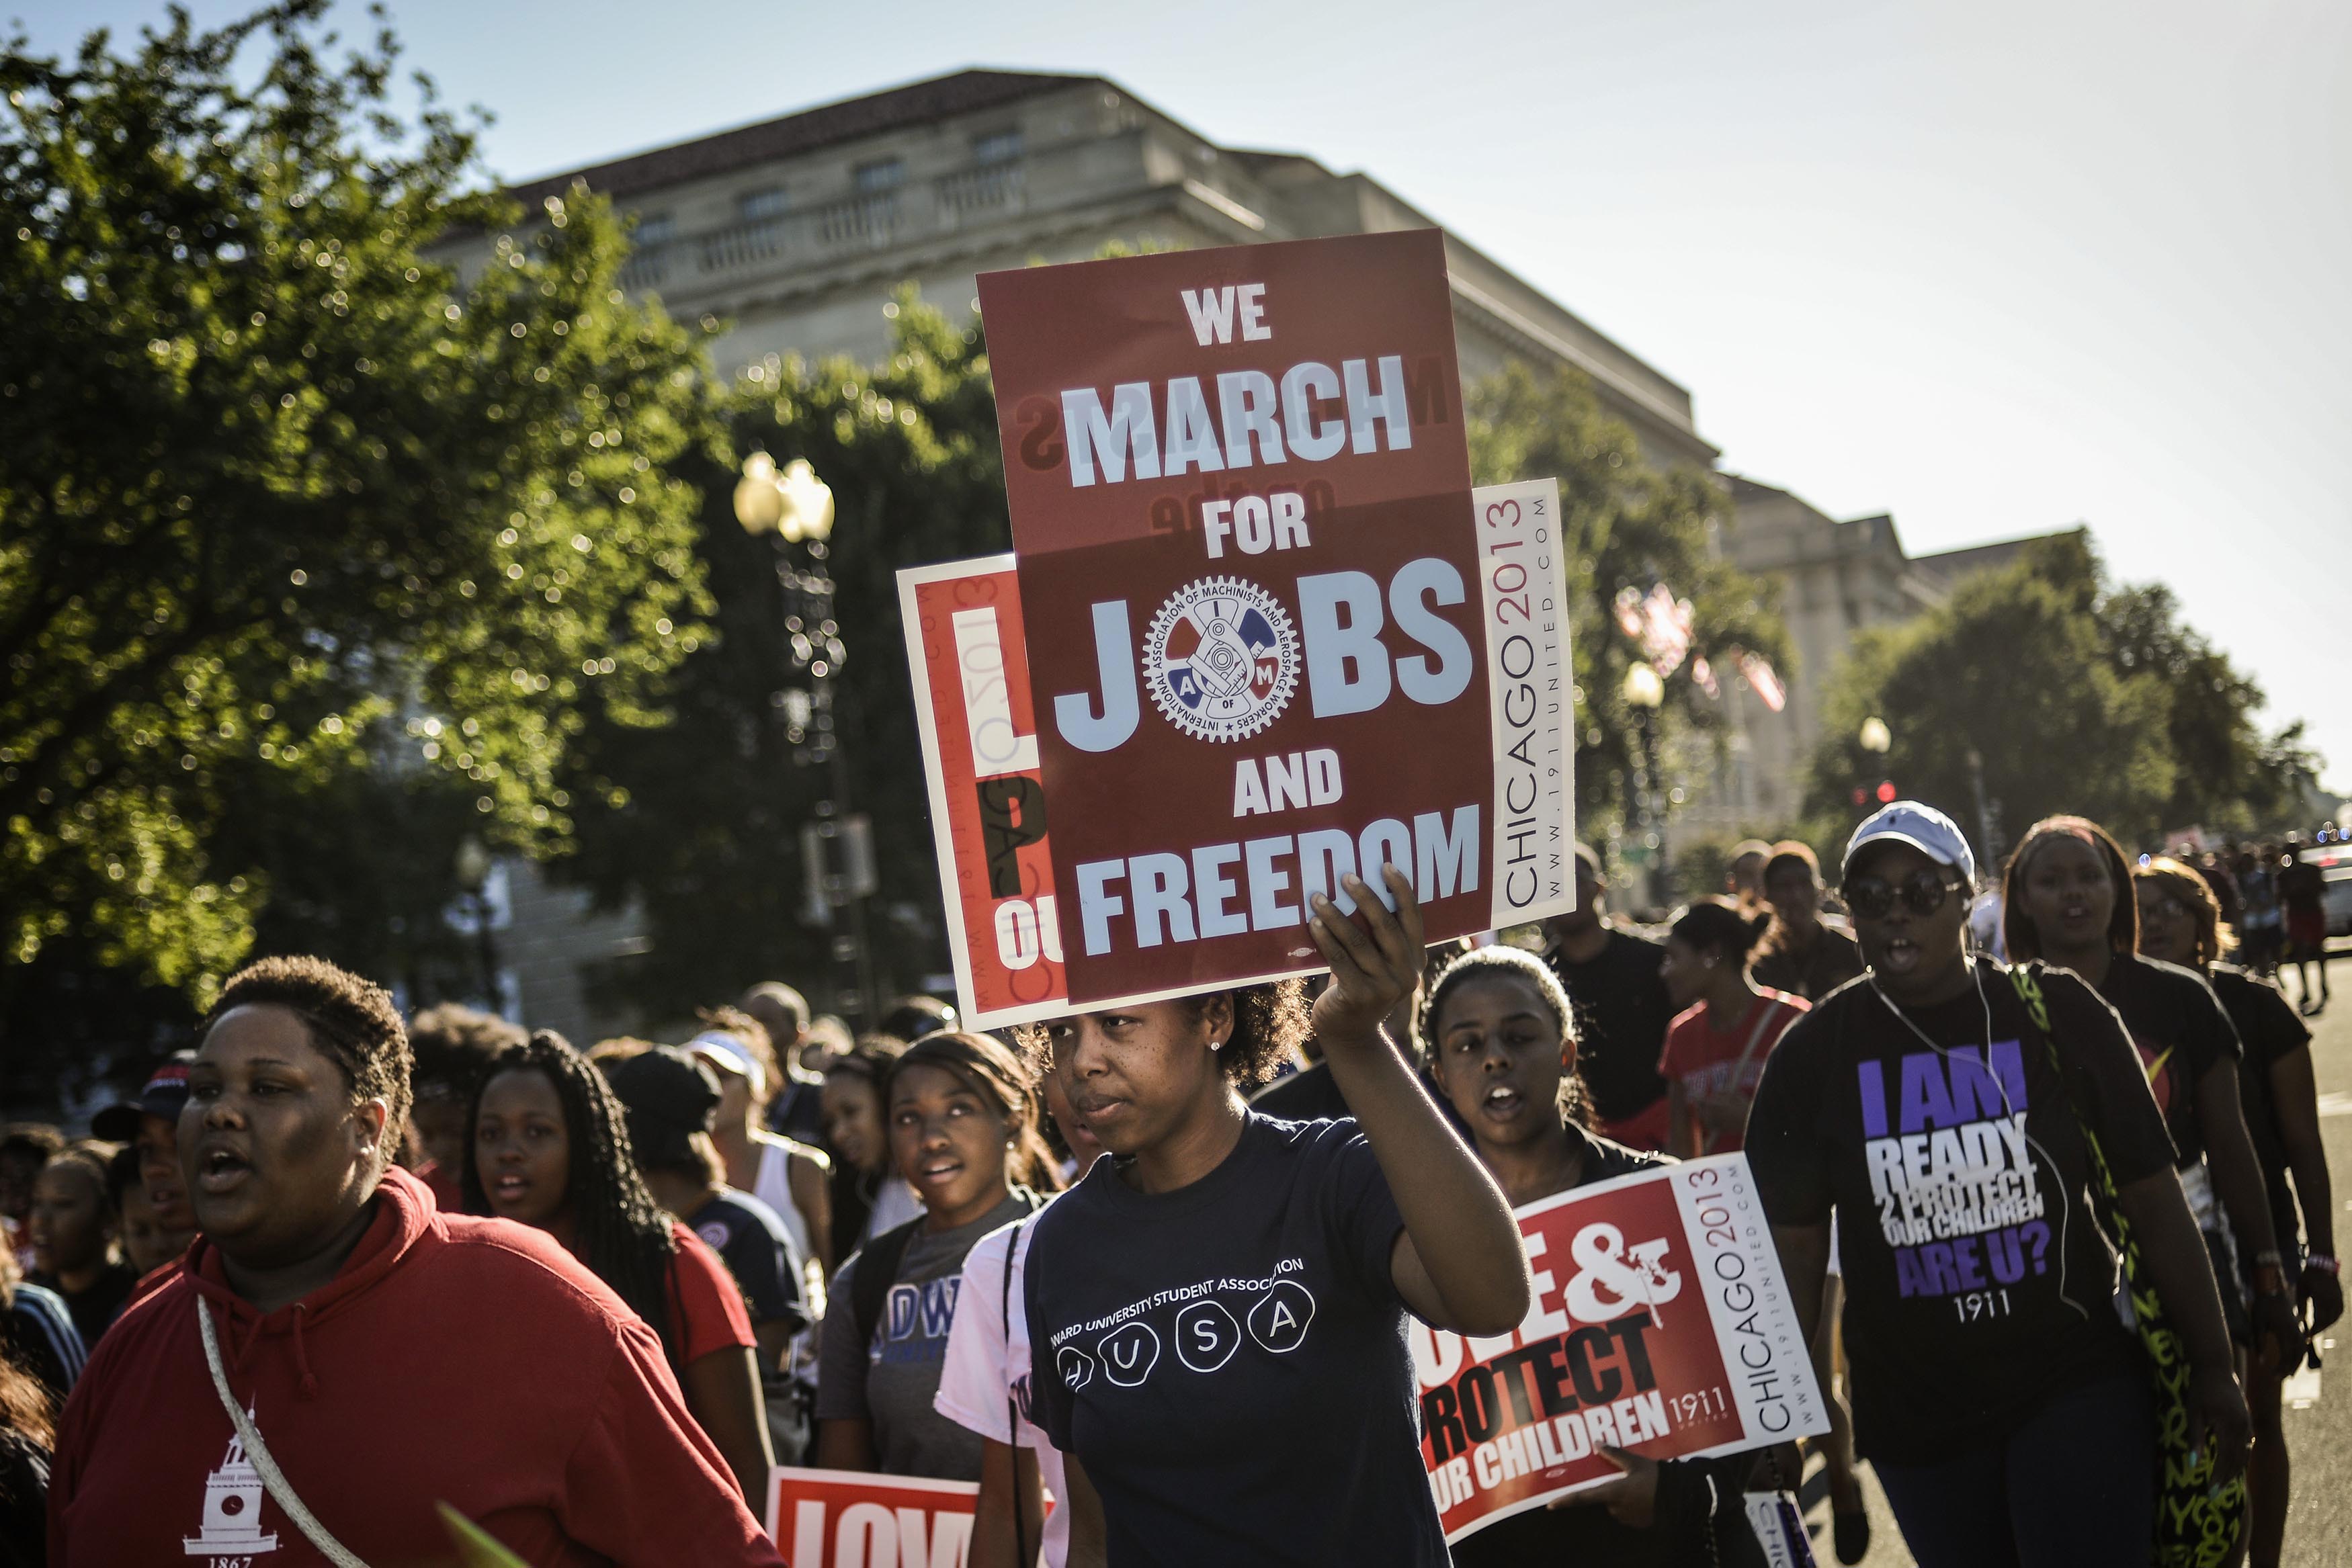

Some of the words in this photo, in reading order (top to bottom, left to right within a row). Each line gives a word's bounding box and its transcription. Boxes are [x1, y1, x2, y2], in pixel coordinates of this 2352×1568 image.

[1181, 283, 1271, 347] WE
[1060, 355, 1413, 488] MARCH
[1201, 492, 1312, 559] FOR
[1185, 591, 1199, 604] OF
[1202, 585, 1263, 607] MACHINISTS
[1262, 607, 1281, 627] AND
[1153, 601, 1185, 669] ASSOCIATION
[1277, 629, 1292, 693] AEROSPACE
[1157, 672, 1219, 732] INTERNATIONAL
[1179, 676, 1196, 697] A
[1222, 699, 1234, 709] OF
[1256, 664, 1273, 685] M
[1532, 498, 1560, 898] WWW.1911UNITED.COM
[1236, 693, 1280, 729] WORKERS
[1232, 748, 1343, 818] AND
[1075, 803, 1479, 957] FREEDOM
[1857, 1059, 1888, 1139] I
[1900, 1039, 2028, 1134] AM
[1882, 1217, 1933, 1247] OUR
[1932, 1192, 2044, 1239] CHILDREN
[1898, 1163, 2038, 1224] PROTECT
[1563, 1222, 1682, 1330] &
[1895, 1237, 1987, 1299] ARE
[1985, 1219, 2051, 1284] U?
[1050, 1323, 1083, 1350] WARD
[1085, 1296, 1152, 1332] UNIVERSITY
[1153, 1279, 1215, 1307] STUDENT
[1217, 1258, 1304, 1291] ASSOCIION
[1954, 1289, 2011, 1323] 1911
[1420, 1311, 1658, 1465] ROTECT
[1669, 1387, 1726, 1424] 1911
[1427, 1455, 1475, 1515] UR
[1472, 1389, 1671, 1491] CHILDREN
